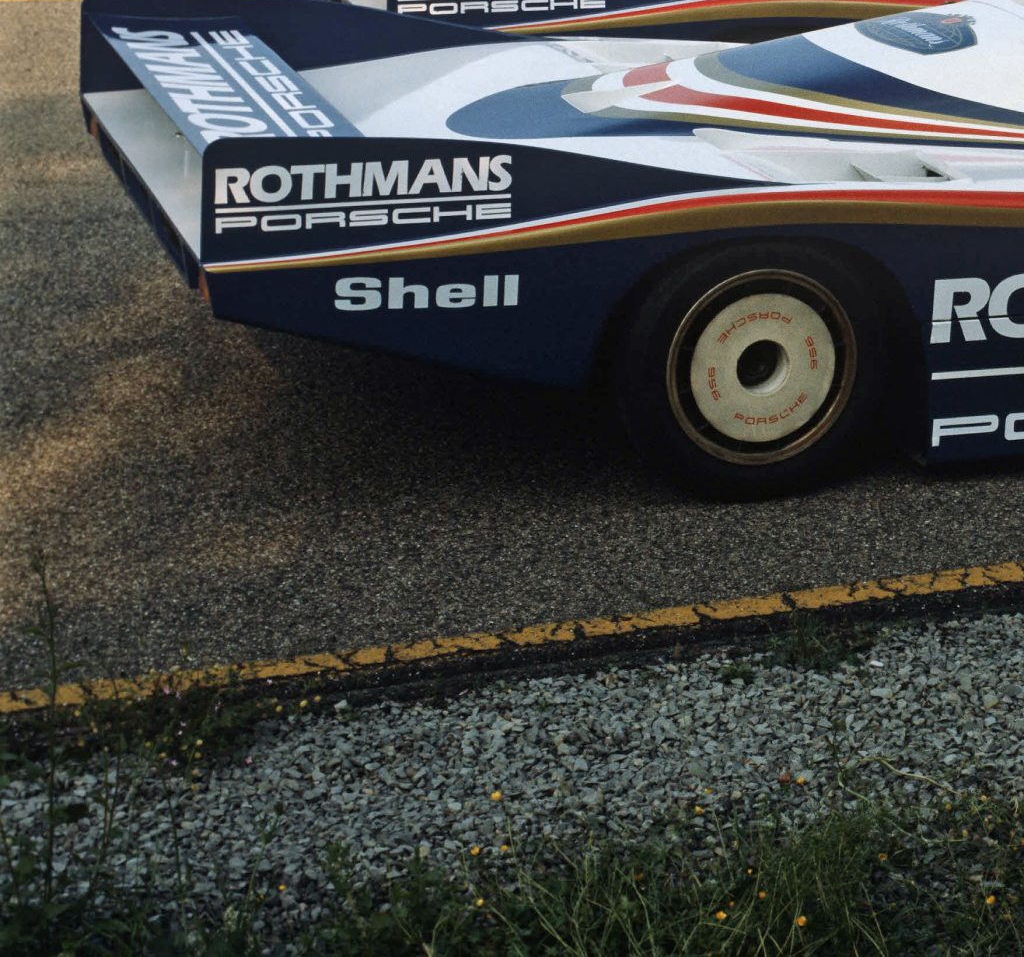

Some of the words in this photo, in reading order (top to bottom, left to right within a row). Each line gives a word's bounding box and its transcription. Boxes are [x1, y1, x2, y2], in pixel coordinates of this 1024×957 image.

[214, 155, 513, 205] ROTHMANS
[214, 203, 512, 234] PORSCHE
[334, 275, 519, 311] Shell
[717, 311, 793, 345] PORSCHE
[804, 335, 818, 370] 956
[708, 366, 721, 401] 956
[733, 392, 807, 425] PORSCHE
